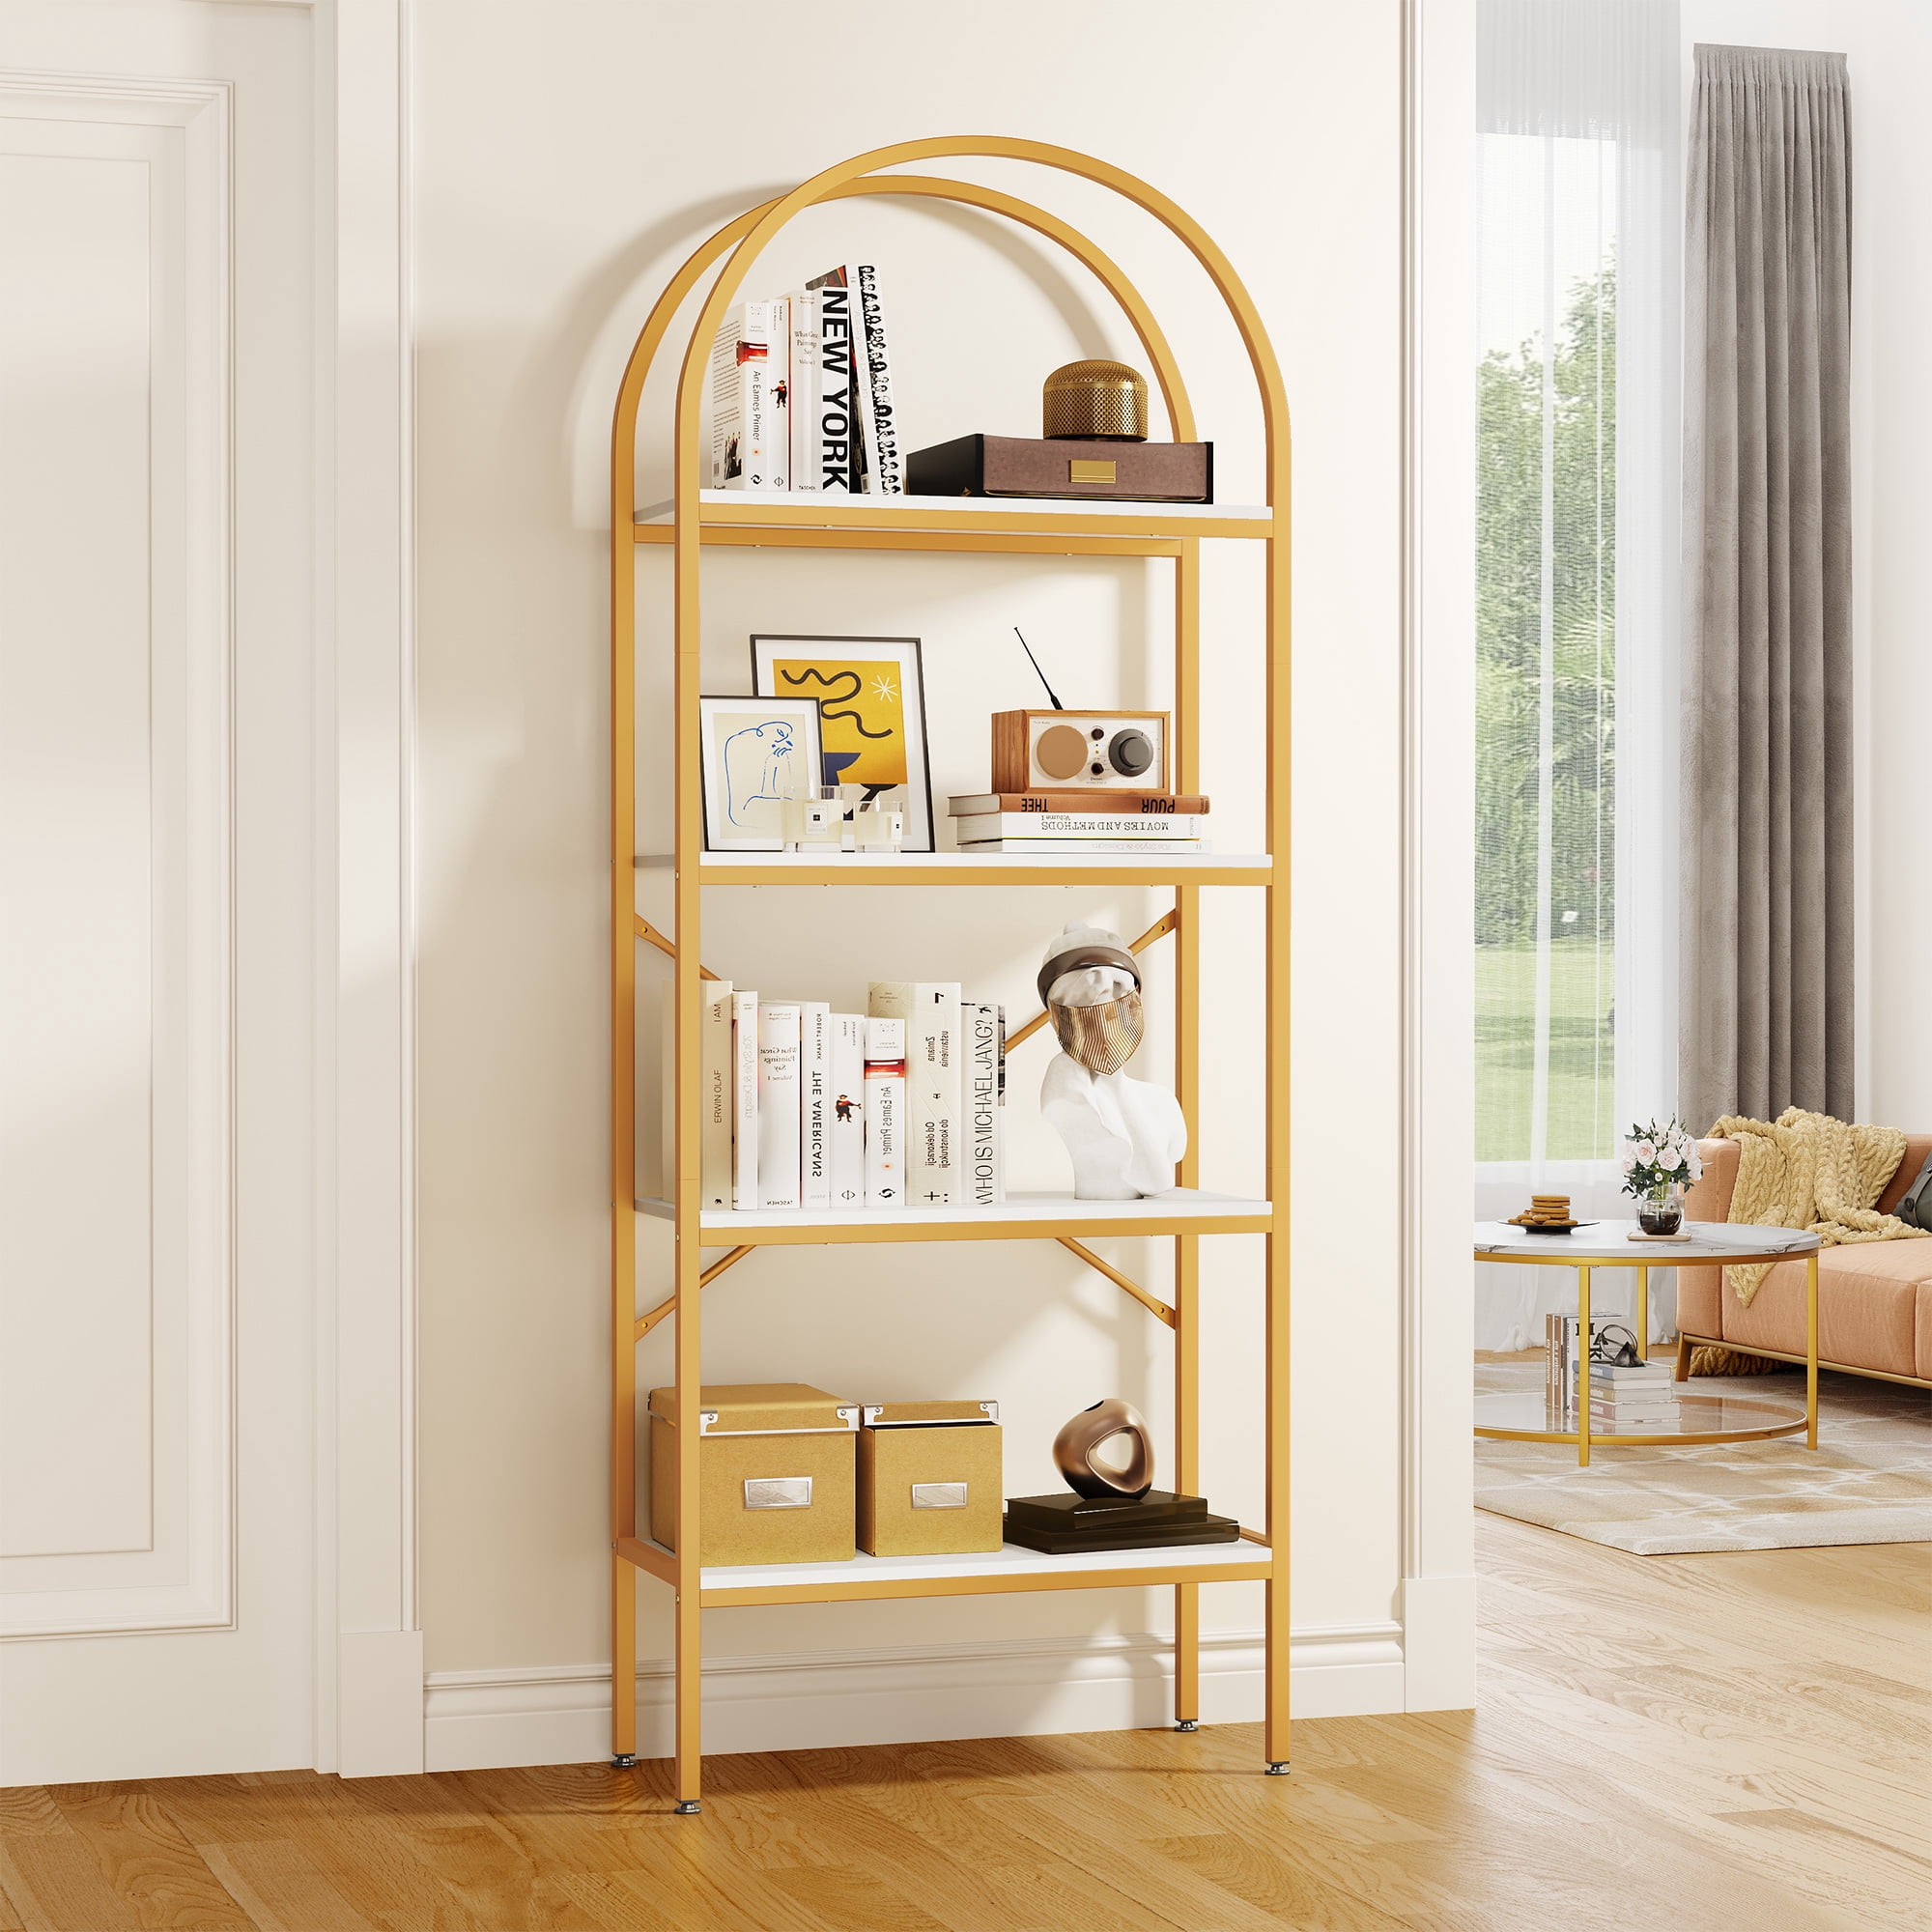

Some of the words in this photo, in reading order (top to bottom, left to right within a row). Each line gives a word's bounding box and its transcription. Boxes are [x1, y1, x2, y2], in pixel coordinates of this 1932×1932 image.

[822, 290, 848, 375] NEW
[753, 371, 761, 382] An
[753, 384, 761, 411] Eames
[753, 413, 761, 440] Primer
[822, 388, 848, 490] YORK
[1021, 798, 1048, 812] THEE
[1141, 799, 1176, 813] PUUR
[1041, 821, 1095, 830] METHODS
[1097, 821, 1122, 830] AND
[1124, 821, 1169, 831] MOVIES
[714, 1004, 721, 1018] AM
[975, 1019, 993, 1070] JANG?
[975, 1072, 992, 1143] MICHAEL
[975, 1148, 992, 1161] IS
[975, 1165, 992, 1206] WHO
